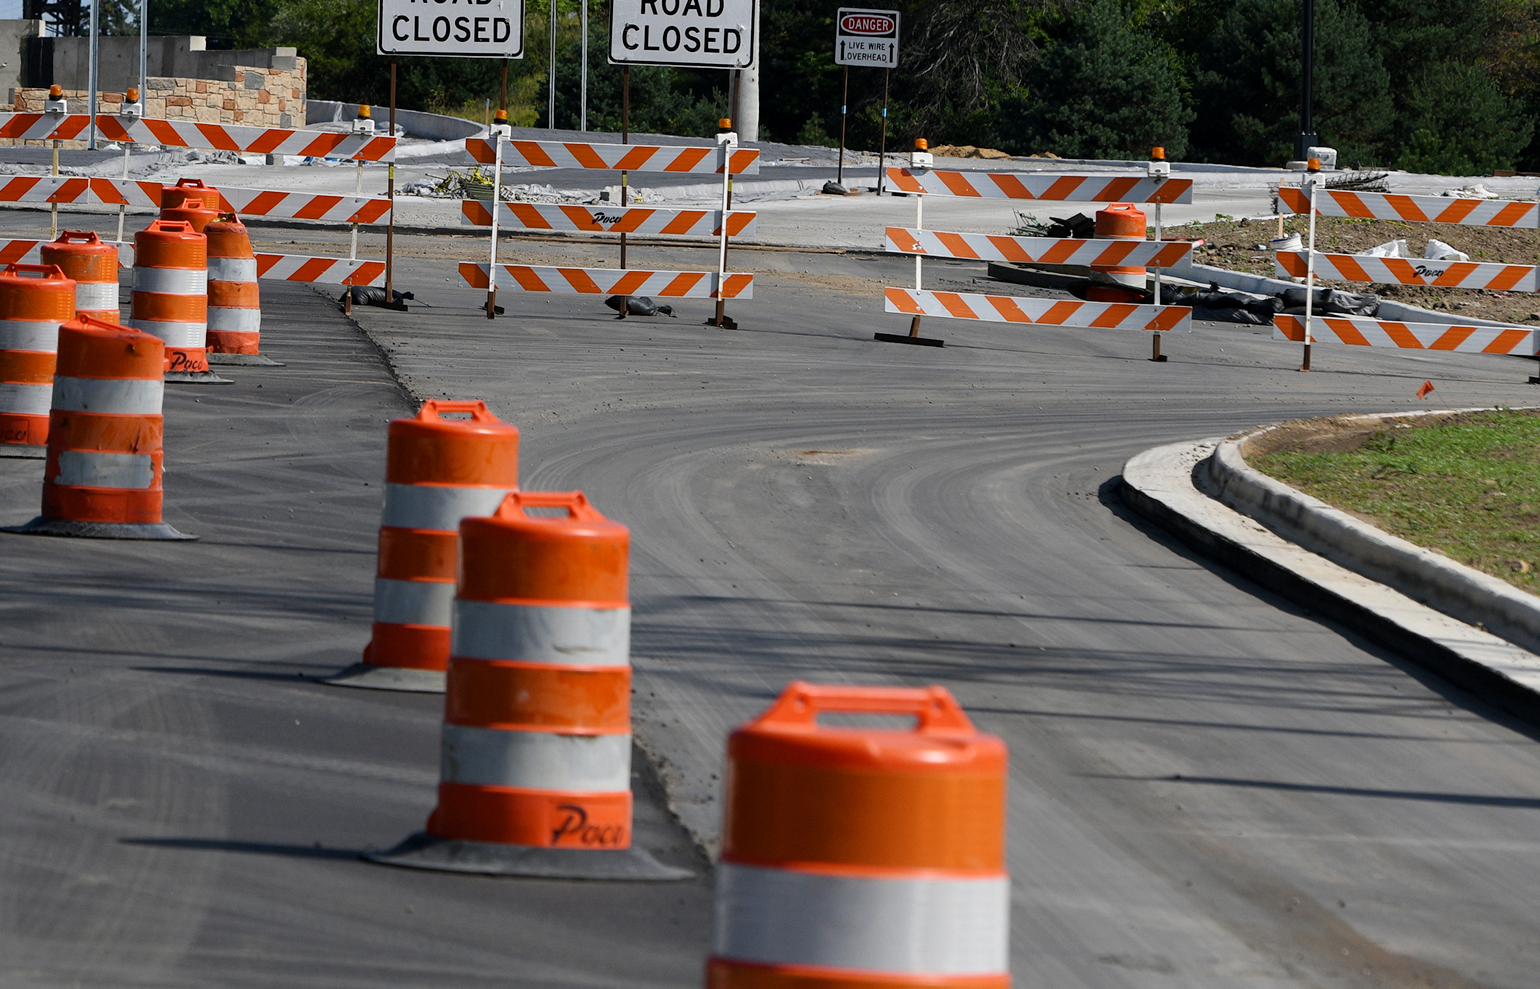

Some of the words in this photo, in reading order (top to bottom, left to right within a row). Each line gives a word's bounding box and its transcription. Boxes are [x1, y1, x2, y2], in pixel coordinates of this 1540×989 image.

[392, 15, 511, 43] CLOSED
[848, 18, 889, 31] DANGER
[622, 23, 741, 54] CLOSED
[848, 42, 865, 50] LIVE
[847, 52, 887, 62] OVERHEAD
